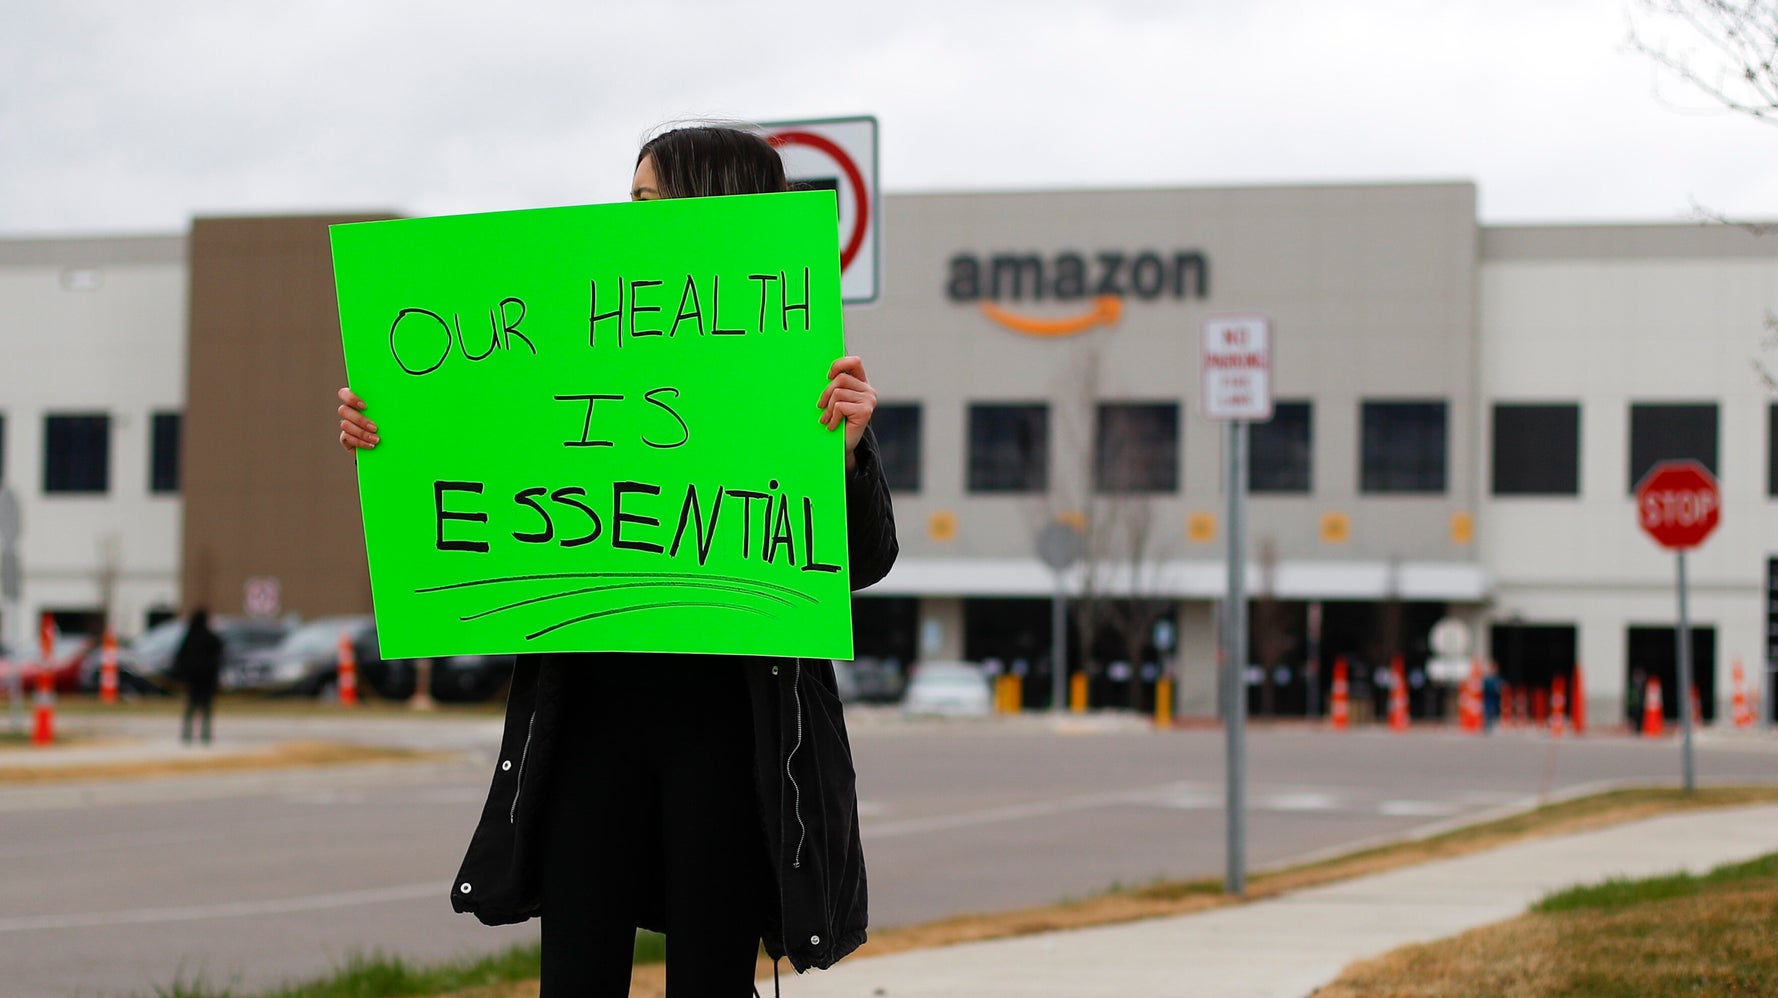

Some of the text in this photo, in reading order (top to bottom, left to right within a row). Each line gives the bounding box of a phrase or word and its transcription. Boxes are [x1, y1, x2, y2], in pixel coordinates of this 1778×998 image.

[947, 250, 1210, 302] amazon
[389, 267, 811, 376] OUR HEALTH
[553, 387, 689, 449] IS
[1643, 488, 1716, 527] STOP
